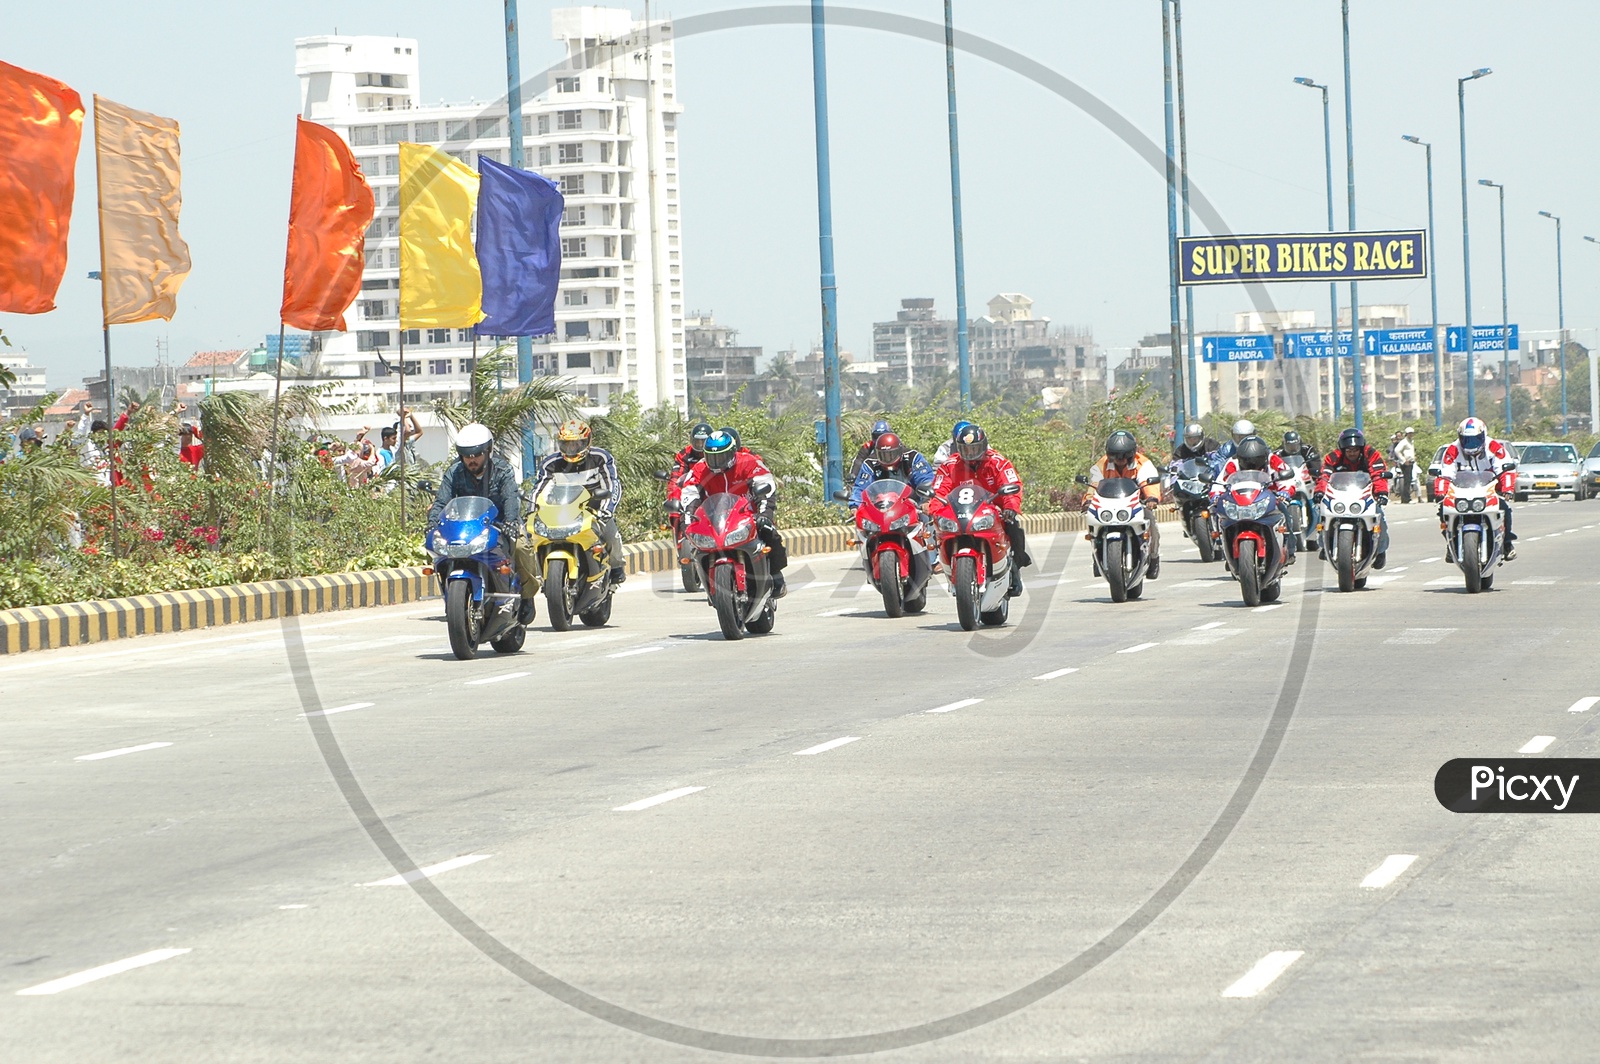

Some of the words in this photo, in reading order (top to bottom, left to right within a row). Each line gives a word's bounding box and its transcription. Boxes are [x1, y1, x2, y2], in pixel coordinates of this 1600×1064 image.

[1191, 244, 1271, 276] SUPER
[1276, 241, 1348, 273] BIKES
[1353, 239, 1414, 271] RACE
[1388, 330, 1426, 340] कलानगर
[1382, 342, 1433, 353] KALANAGAR
[1473, 339, 1505, 350] AIRPOR
[1228, 350, 1264, 361] BANDRA
[1305, 347, 1314, 357] S.
[1315, 346, 1323, 356] V.
[957, 488, 975, 505] 8
